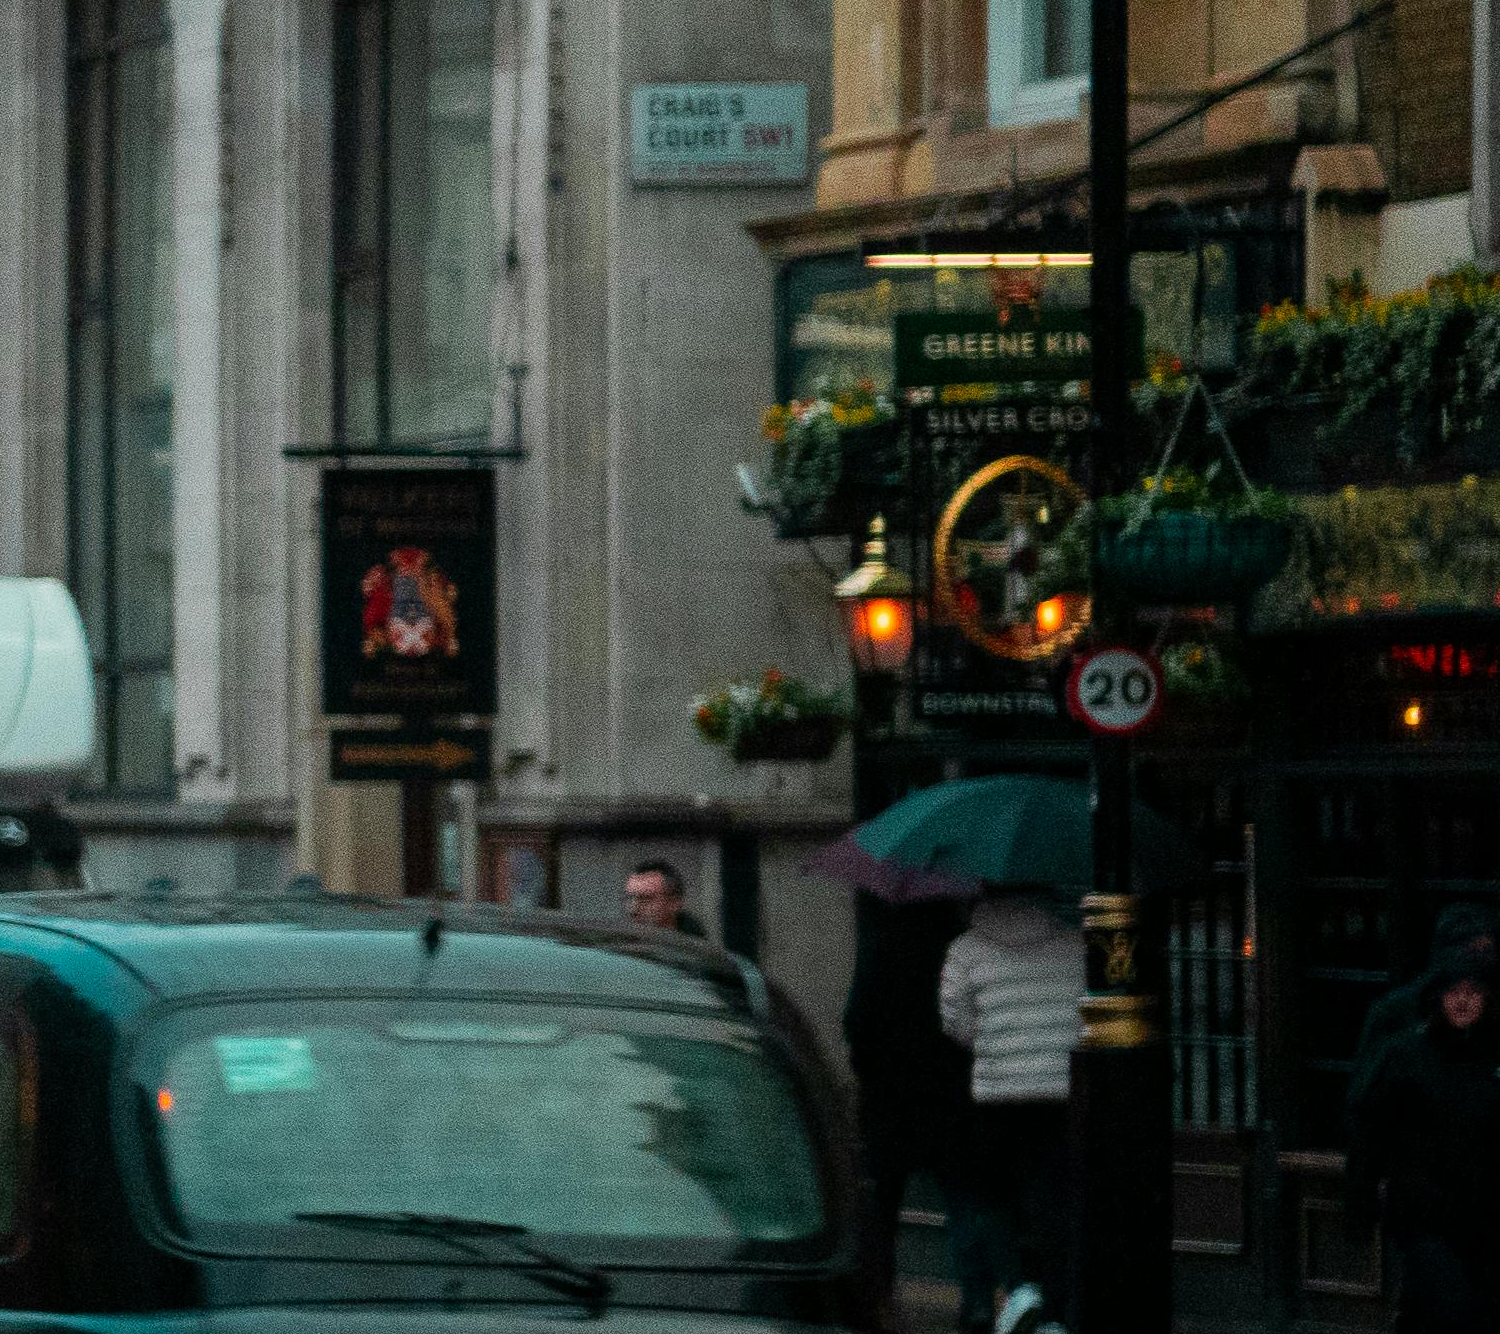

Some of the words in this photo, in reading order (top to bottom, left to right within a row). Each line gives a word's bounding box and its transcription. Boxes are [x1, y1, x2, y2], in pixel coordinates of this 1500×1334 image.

[648, 124, 728, 149] COURT
[743, 123, 795, 149] SW1
[922, 331, 1036, 360] GREENE
[1044, 330, 1093, 357] KIN
[925, 407, 1019, 433] SILVER
[1026, 406, 1092, 433] CRO
[1086, 668, 1153, 707] 20
